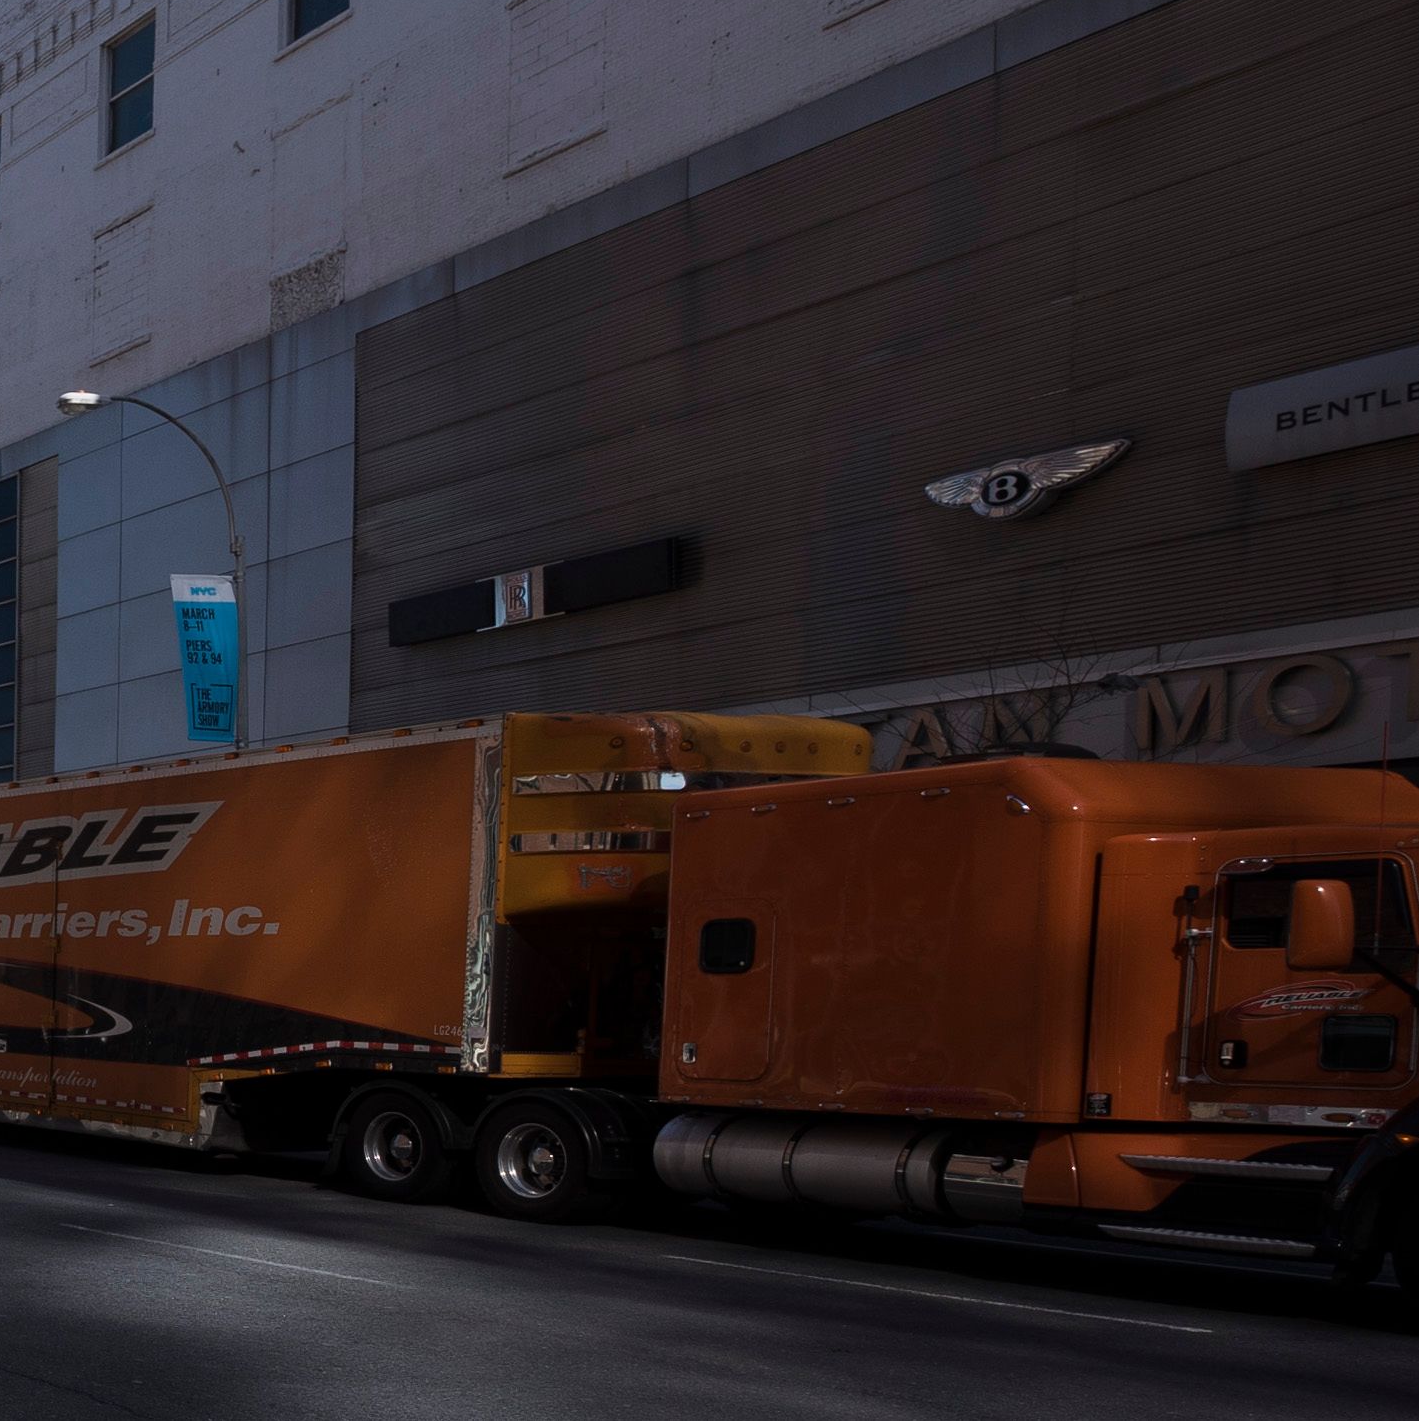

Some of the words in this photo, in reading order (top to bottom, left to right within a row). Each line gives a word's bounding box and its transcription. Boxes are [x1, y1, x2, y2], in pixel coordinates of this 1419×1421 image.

[190, 586, 216, 596] NYC
[182, 608, 215, 620] MARCH
[186, 640, 212, 652] PIERS
[187, 652, 198, 664] 92
[201, 653, 208, 664] &
[211, 653, 222, 665] 94
[197, 688, 211, 701] THE
[197, 701, 230, 715] ARMORY
[198, 714, 220, 727] SHOW
[168, 899, 280, 937] Inc.
[1262, 988, 1365, 1008] RELIABLE
